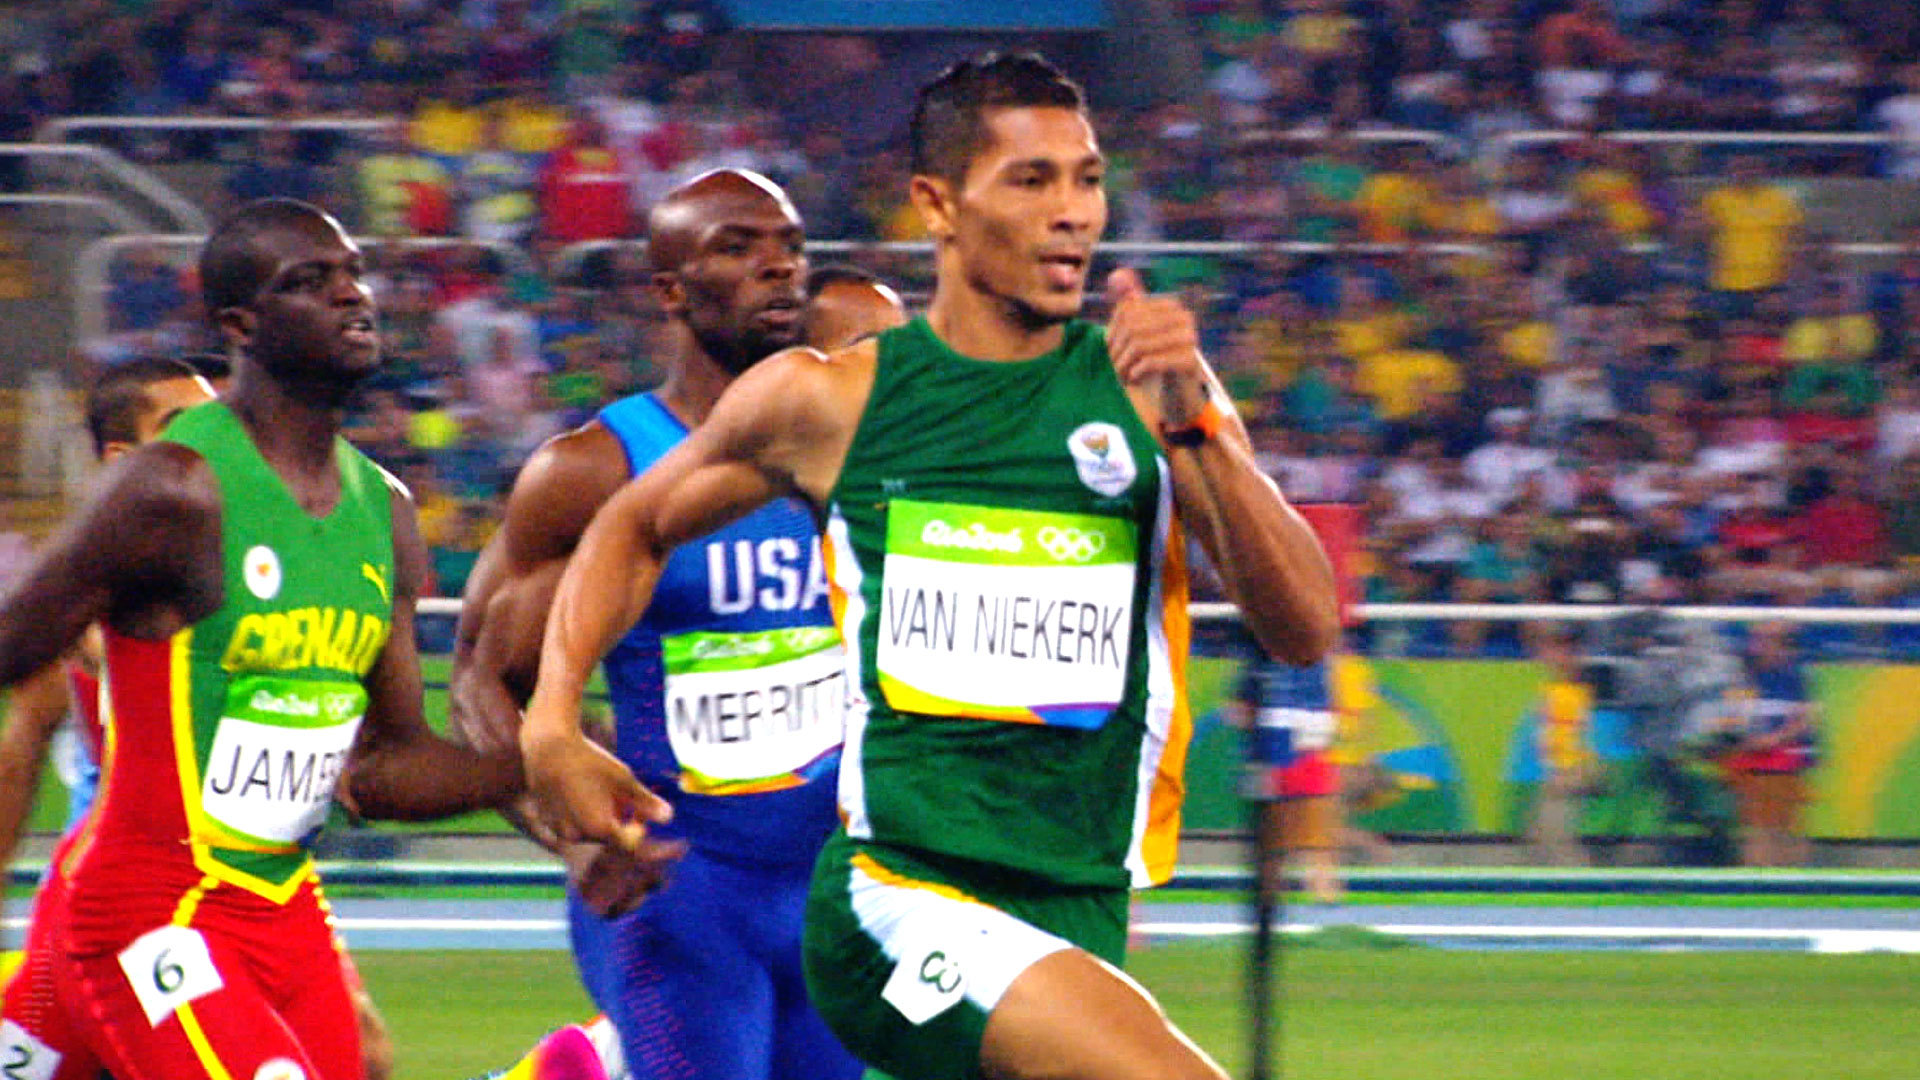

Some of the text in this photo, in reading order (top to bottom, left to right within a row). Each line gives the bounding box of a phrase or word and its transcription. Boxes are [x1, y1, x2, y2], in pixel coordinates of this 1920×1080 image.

[707, 536, 829, 615] USA
[220, 607, 389, 676] GRENAD
[888, 586, 1124, 669] VAN NIEKERK
[152, 948, 185, 994] 6
[1, 1044, 33, 1080] 2
